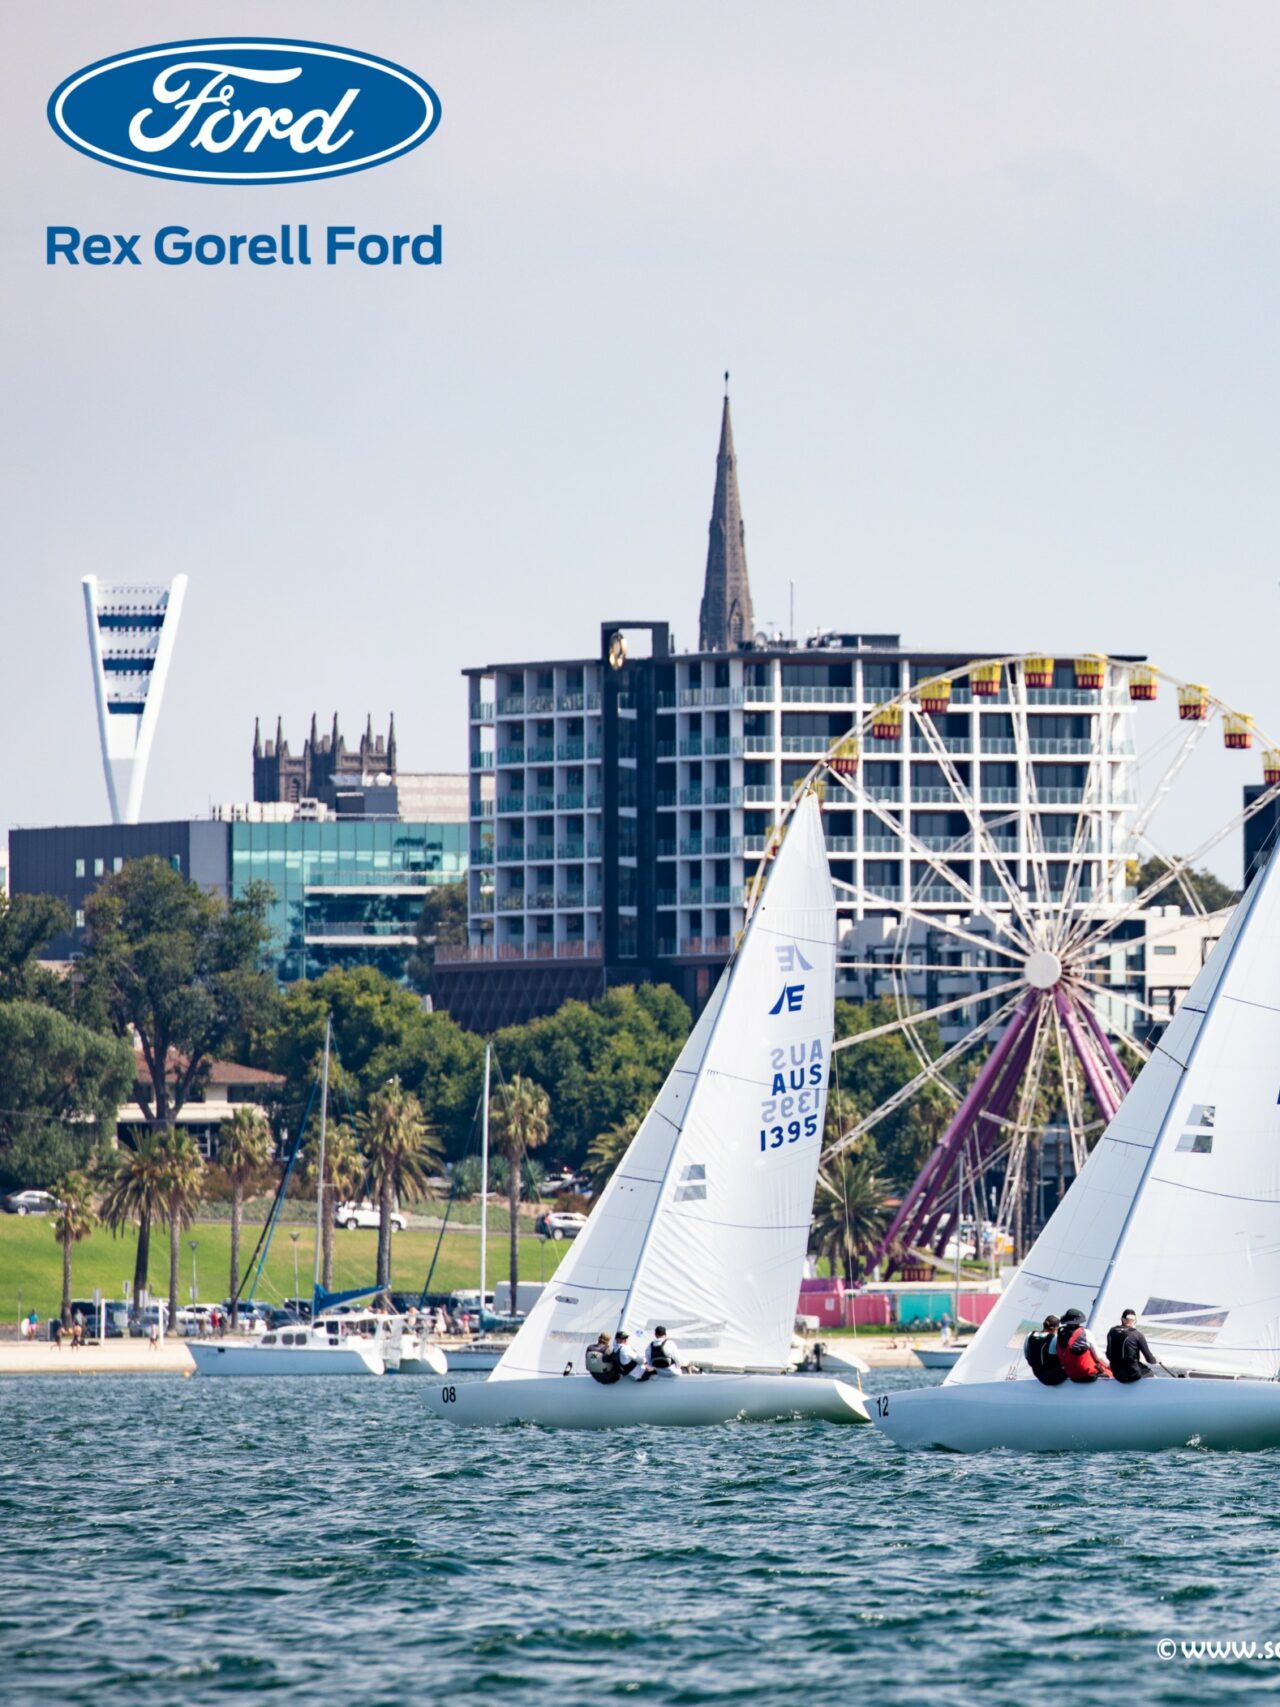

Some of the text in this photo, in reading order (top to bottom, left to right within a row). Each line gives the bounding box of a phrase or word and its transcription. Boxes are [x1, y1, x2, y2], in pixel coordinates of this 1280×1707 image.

[772, 1063, 822, 1096] AUS
[760, 1114, 817, 1152] 1395
[442, 1386, 456, 1403] 08
[876, 1395, 889, 1418] 12
